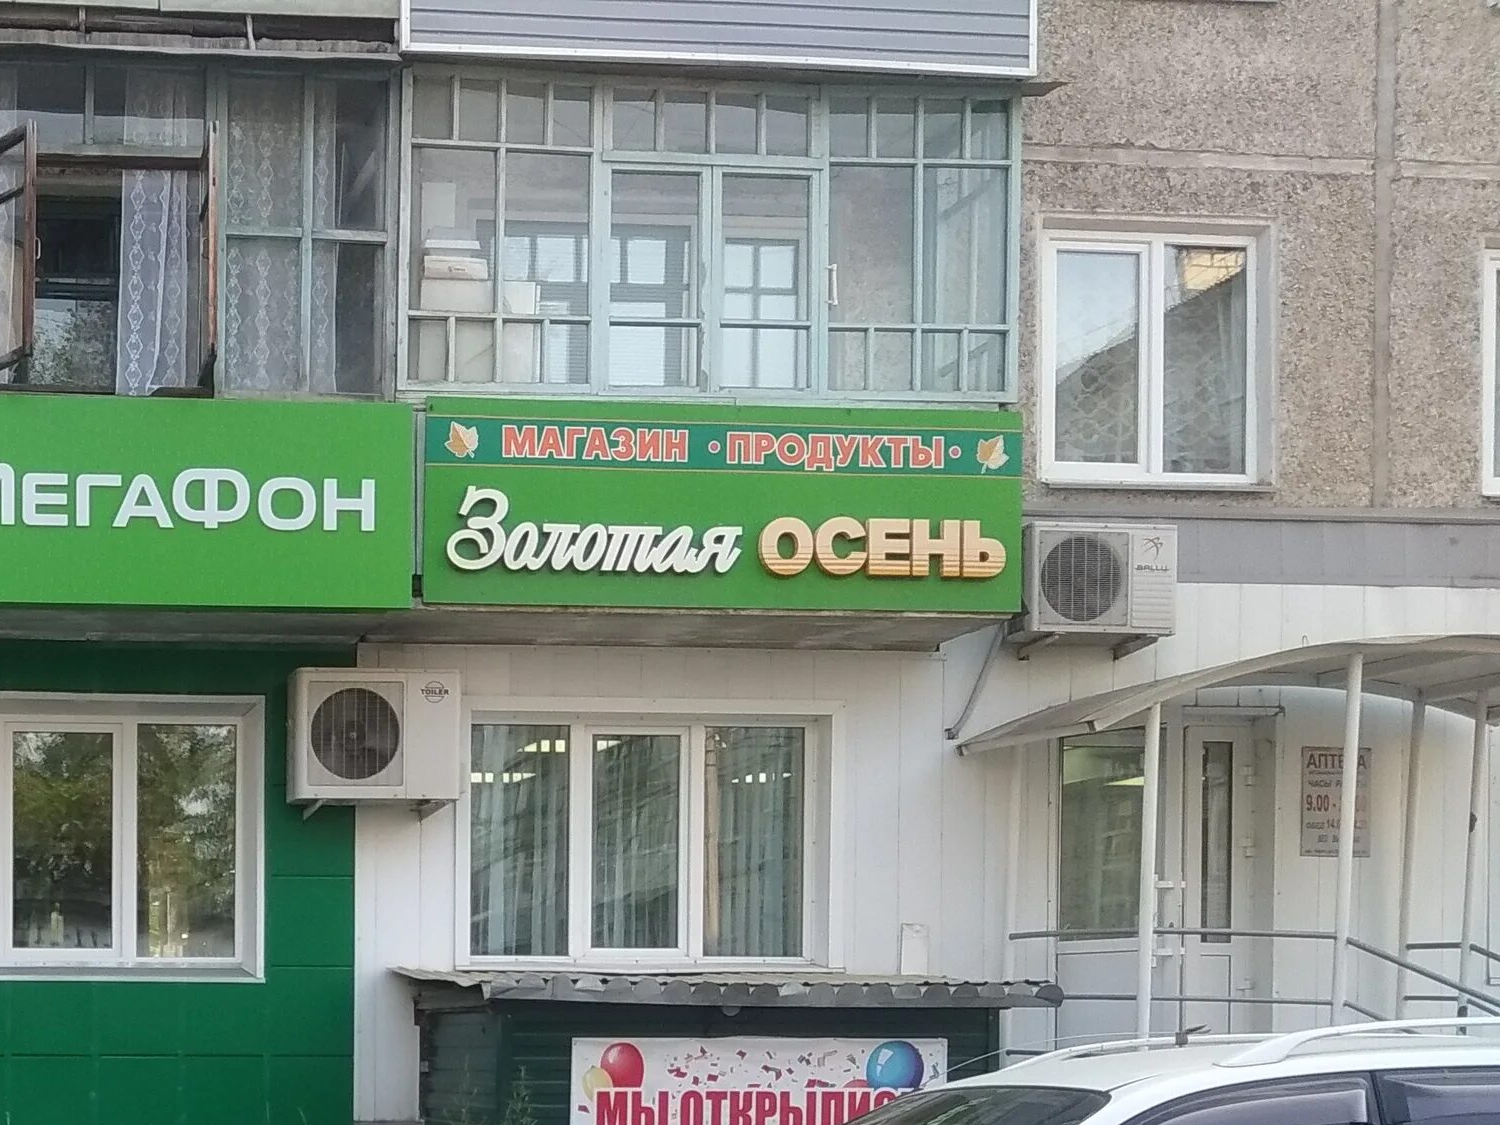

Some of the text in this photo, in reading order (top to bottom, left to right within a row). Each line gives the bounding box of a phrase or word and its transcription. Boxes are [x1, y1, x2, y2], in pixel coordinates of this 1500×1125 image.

[501, 425, 946, 471] МАГАЗИН ПРОДУКТЫ
[446, 485, 1008, 579] Золотая ОСЕНЬ
[1306, 753, 1368, 770] АПТЕА
[1306, 794, 1330, 812] 9.00
